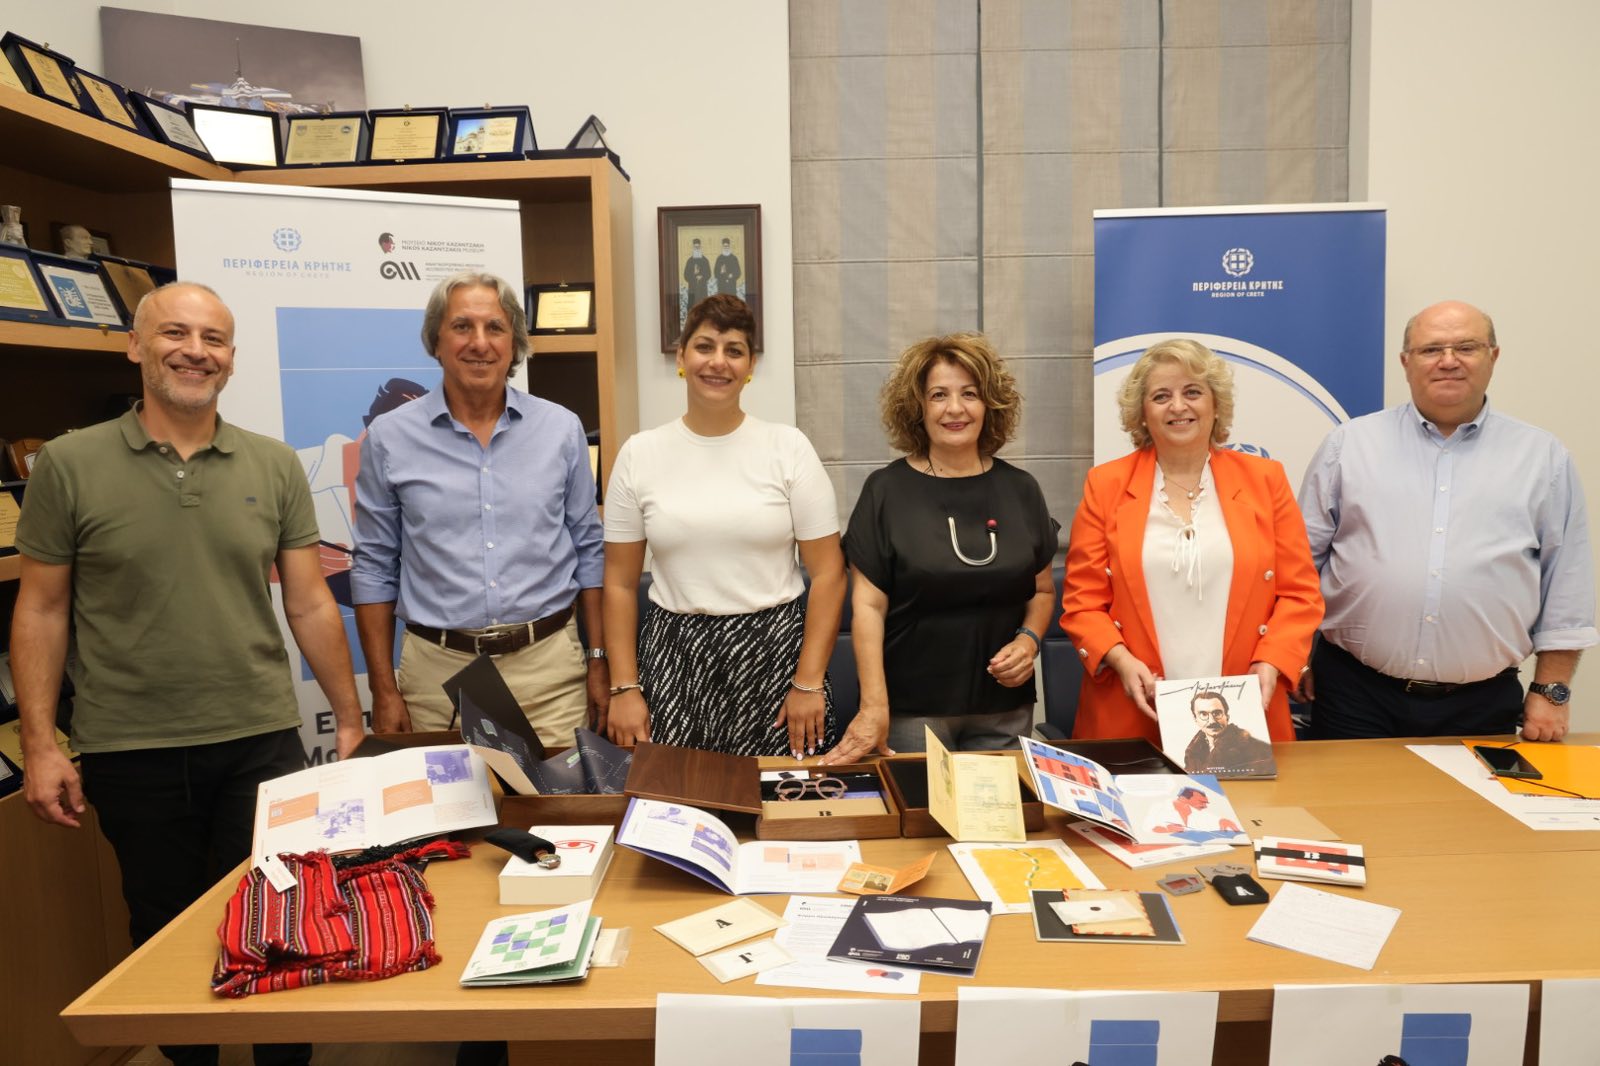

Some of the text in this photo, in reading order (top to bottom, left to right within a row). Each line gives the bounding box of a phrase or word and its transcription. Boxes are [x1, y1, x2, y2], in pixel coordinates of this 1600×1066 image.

[222, 258, 352, 272] ΠΕΡΙΦΕΡΕΙΑ ΚΡΗΤΗΣ
[1192, 280, 1284, 291] ΠΕΡΙΦΕΡΕΙΑ ΚΡΗΤΗΣ
